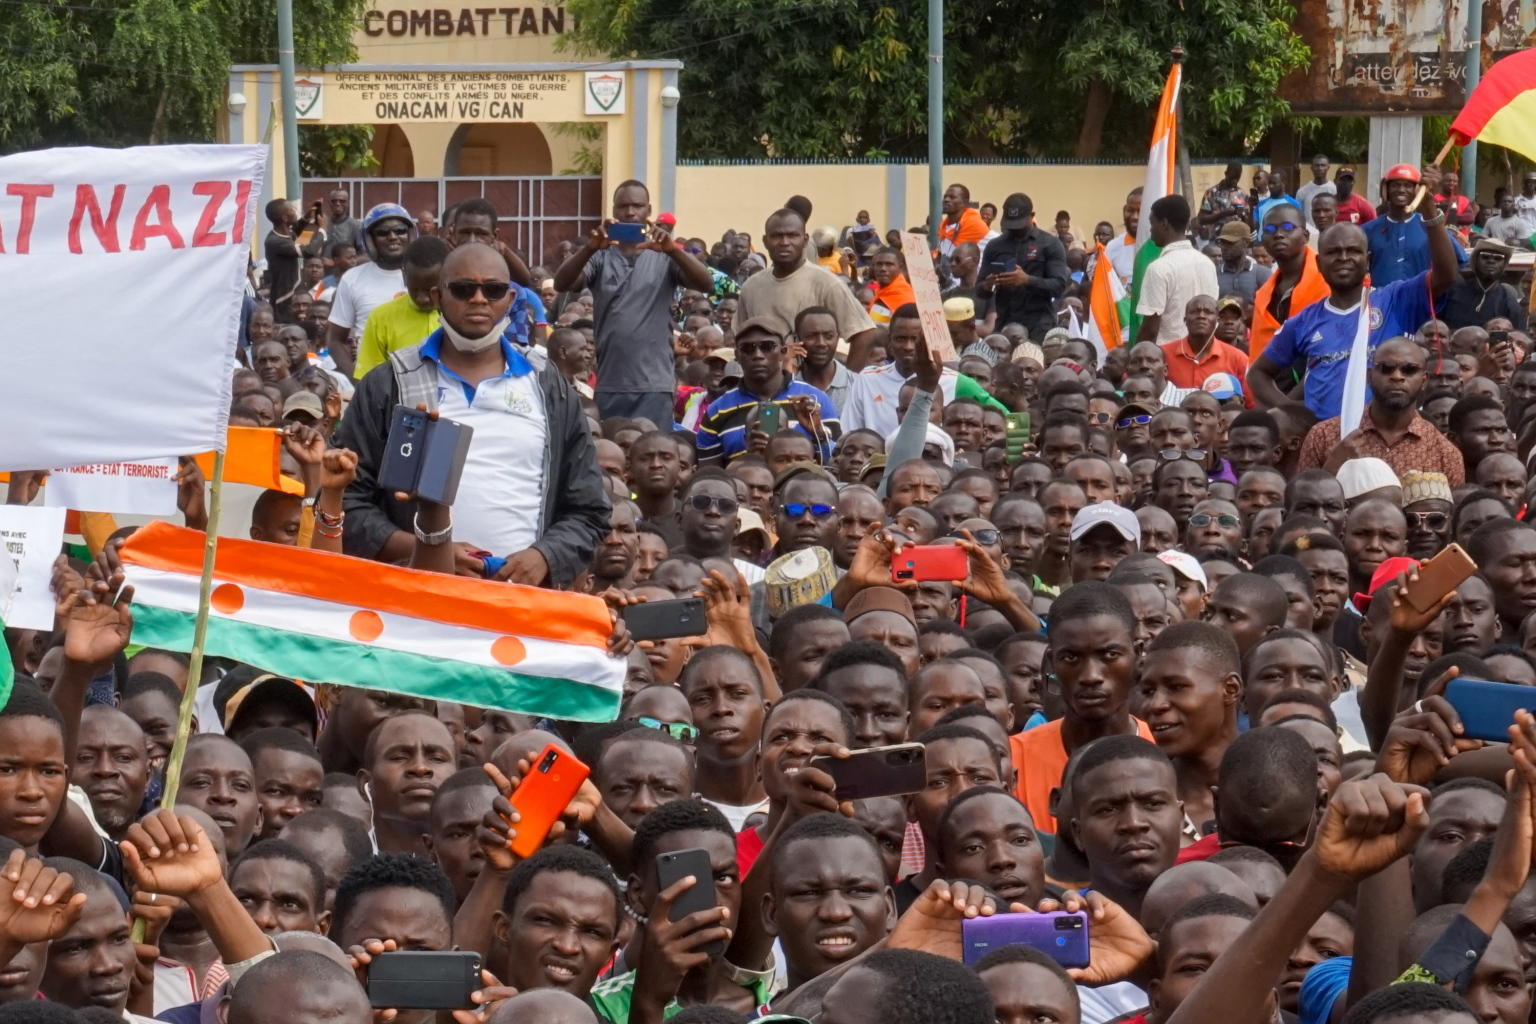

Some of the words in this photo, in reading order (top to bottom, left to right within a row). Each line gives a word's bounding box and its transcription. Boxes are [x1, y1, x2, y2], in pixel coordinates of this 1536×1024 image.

[365, 7, 580, 38] COMBATTAN
[335, 73, 370, 82] OFFICE
[375, 73, 424, 82] NATIONAL
[427, 73, 447, 82] DES
[450, 73, 491, 82] ANCIENS
[339, 82, 381, 91] ANCIENS
[385, 83, 439, 91] MILITAIRES
[462, 83, 507, 91] VICTIMES
[511, 83, 525, 91] DE
[529, 83, 567, 91] GUERRE
[361, 92, 374, 100] ET
[379, 92, 398, 100] DES
[403, 92, 450, 100] CONFLITS
[494, 92, 507, 100] DU
[68, 180, 252, 254] NAZI
[102, 463, 121, 475] ETAT
[122, 463, 169, 479] TERRORISTE
